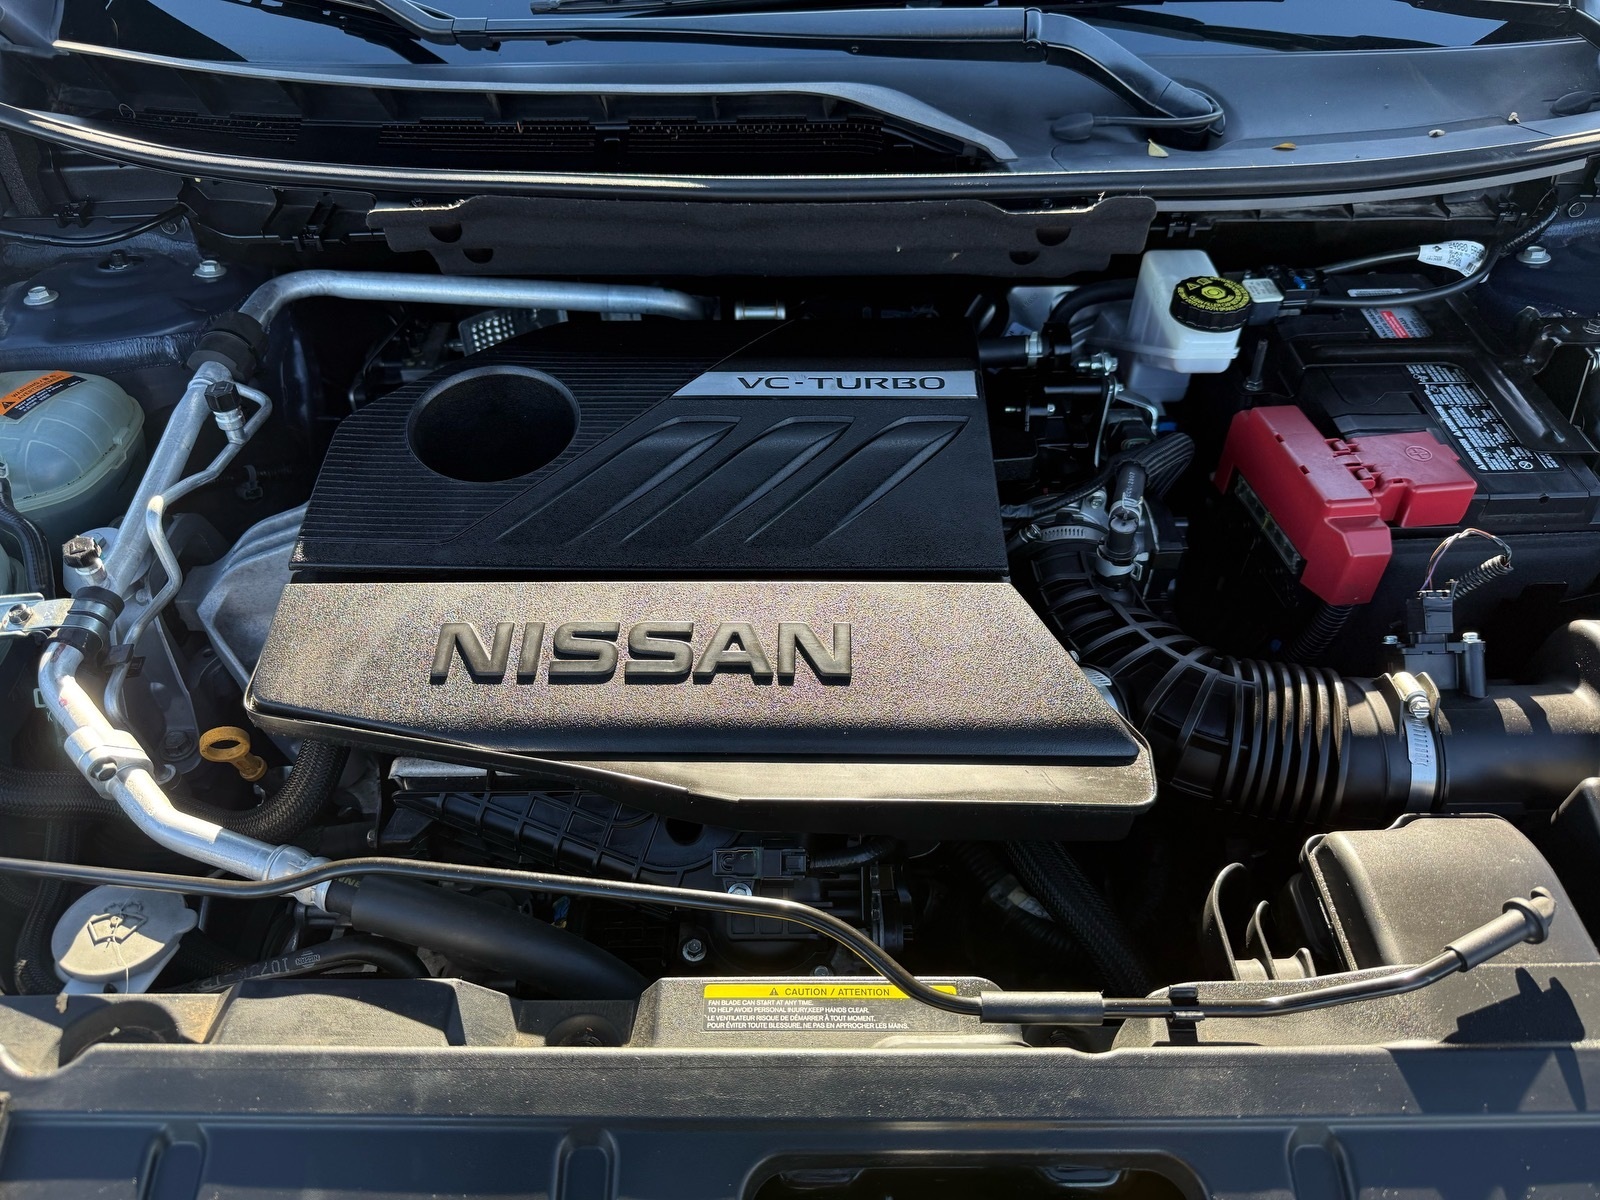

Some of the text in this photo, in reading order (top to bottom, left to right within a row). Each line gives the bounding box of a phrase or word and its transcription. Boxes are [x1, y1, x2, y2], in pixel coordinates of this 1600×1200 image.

[737, 375, 945, 390] VC-TURBO
[430, 621, 852, 686] NISSAN
[784, 987, 890, 996] CAUTION / ATTENTION
[790, 1013, 824, 1021] DÉMARRER
[726, 1020, 747, 1029] ÉVITER
[888, 1022, 910, 1030] MAINS.
